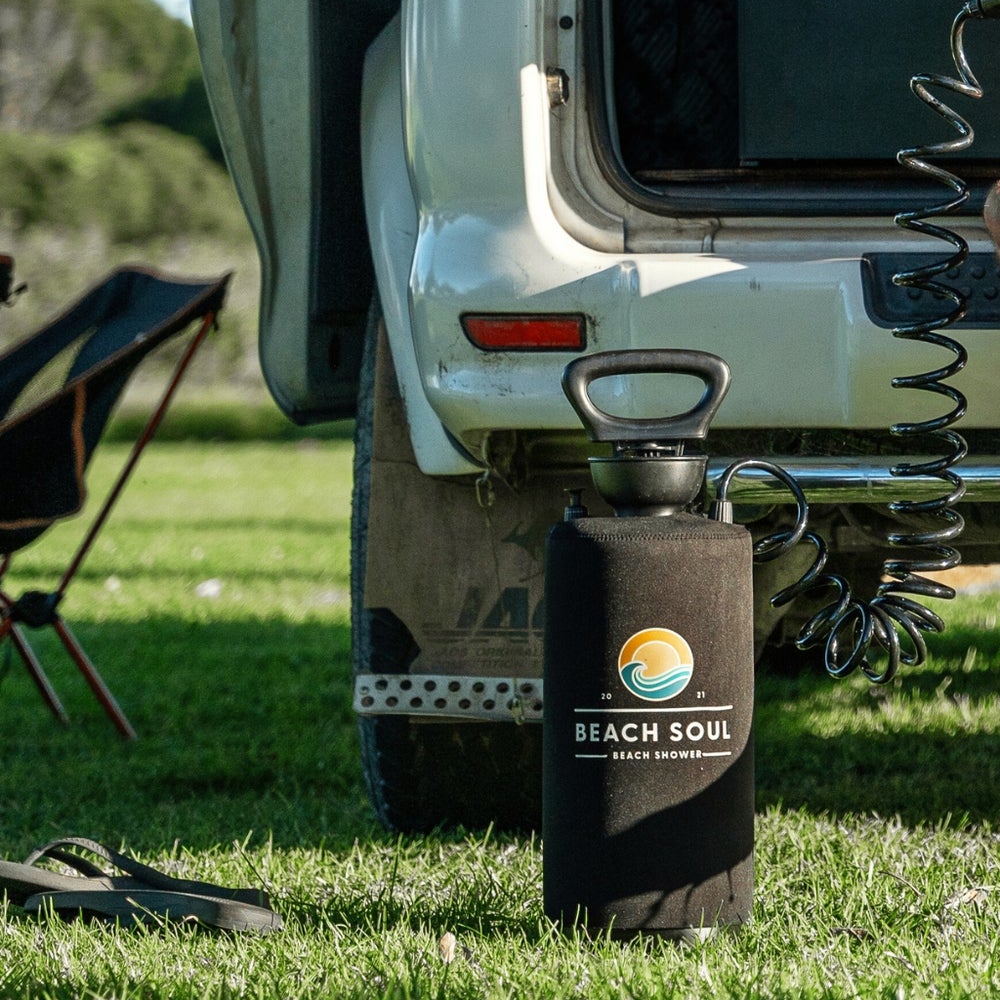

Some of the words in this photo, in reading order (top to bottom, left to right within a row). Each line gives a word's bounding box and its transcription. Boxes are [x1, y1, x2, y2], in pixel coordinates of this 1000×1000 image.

[601, 692, 612, 700] 20
[575, 723, 659, 742] BEACH
[670, 720, 731, 742] SOUL
[613, 751, 650, 760] BEACH
[655, 750, 702, 760] SHOWER
